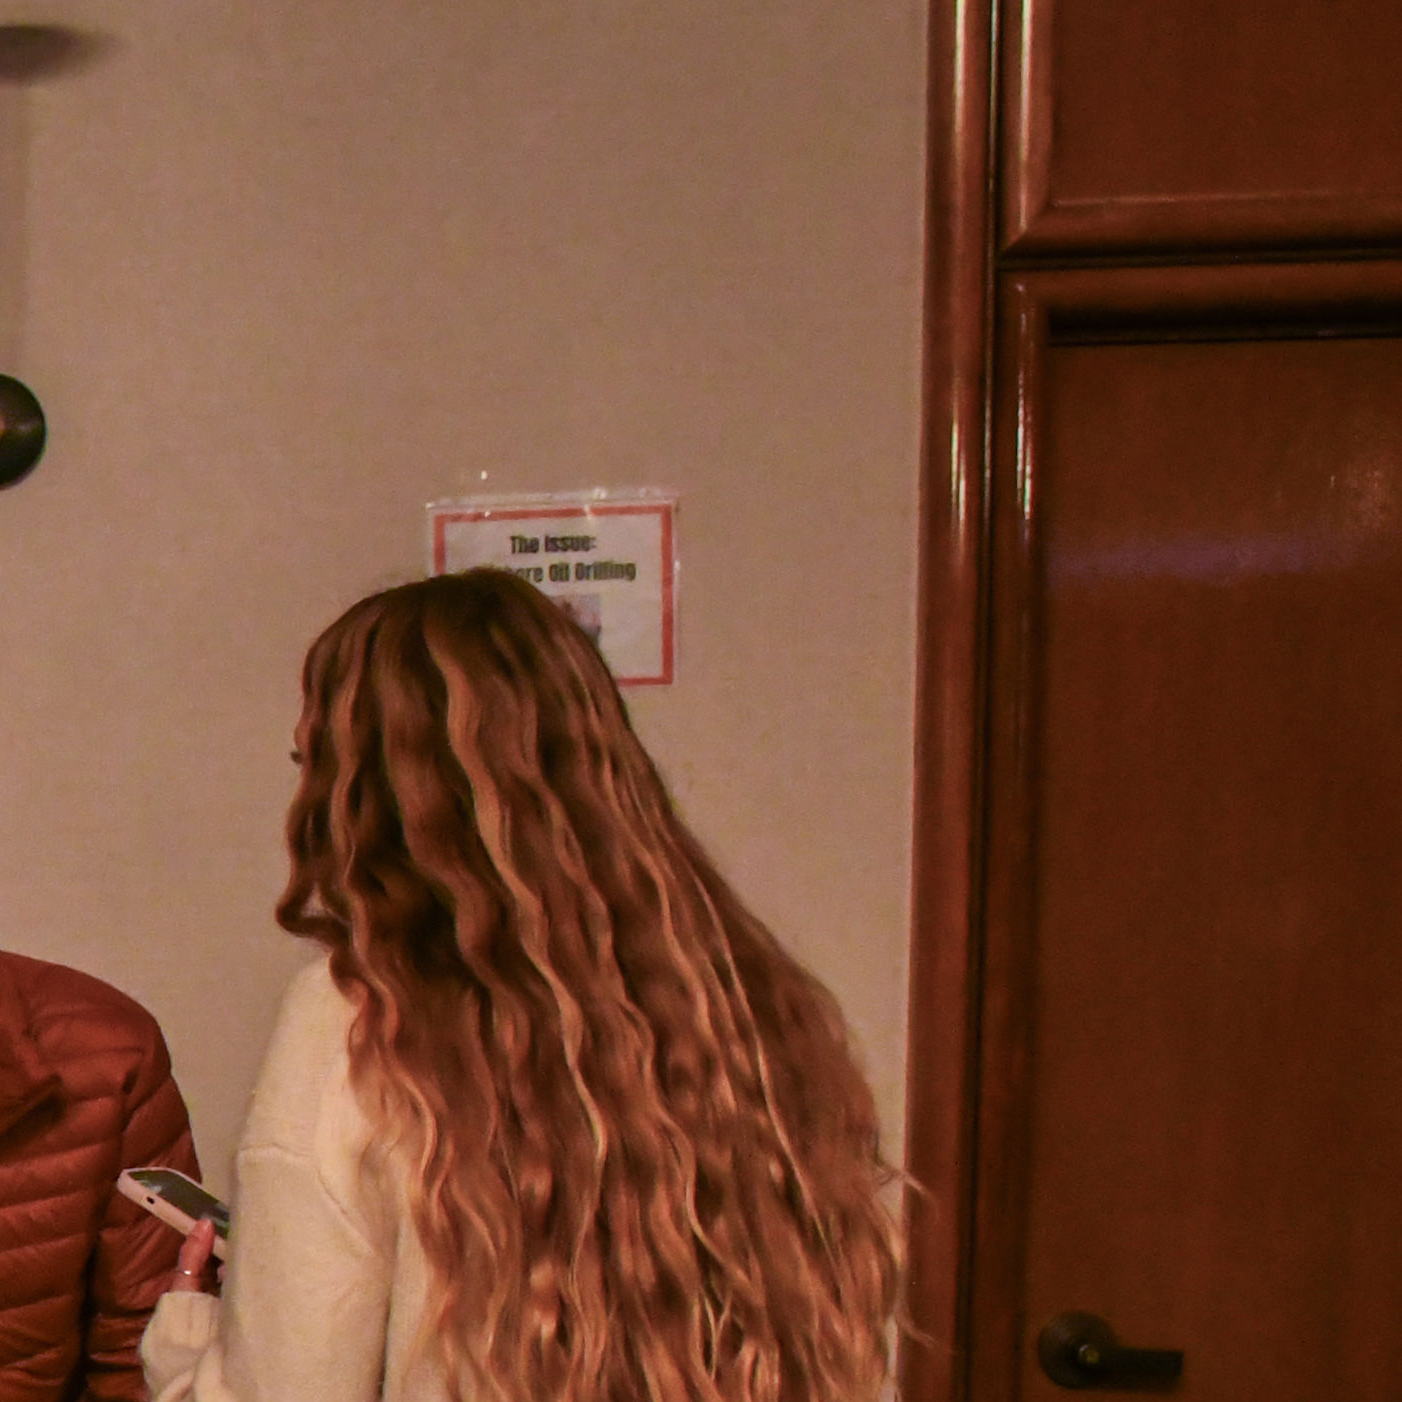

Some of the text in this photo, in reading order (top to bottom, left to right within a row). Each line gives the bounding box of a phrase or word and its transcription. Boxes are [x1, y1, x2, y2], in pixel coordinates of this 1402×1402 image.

[510, 534, 596, 554] The Issue:
[549, 563, 570, 582] Oil
[575, 561, 637, 582] Drilling
